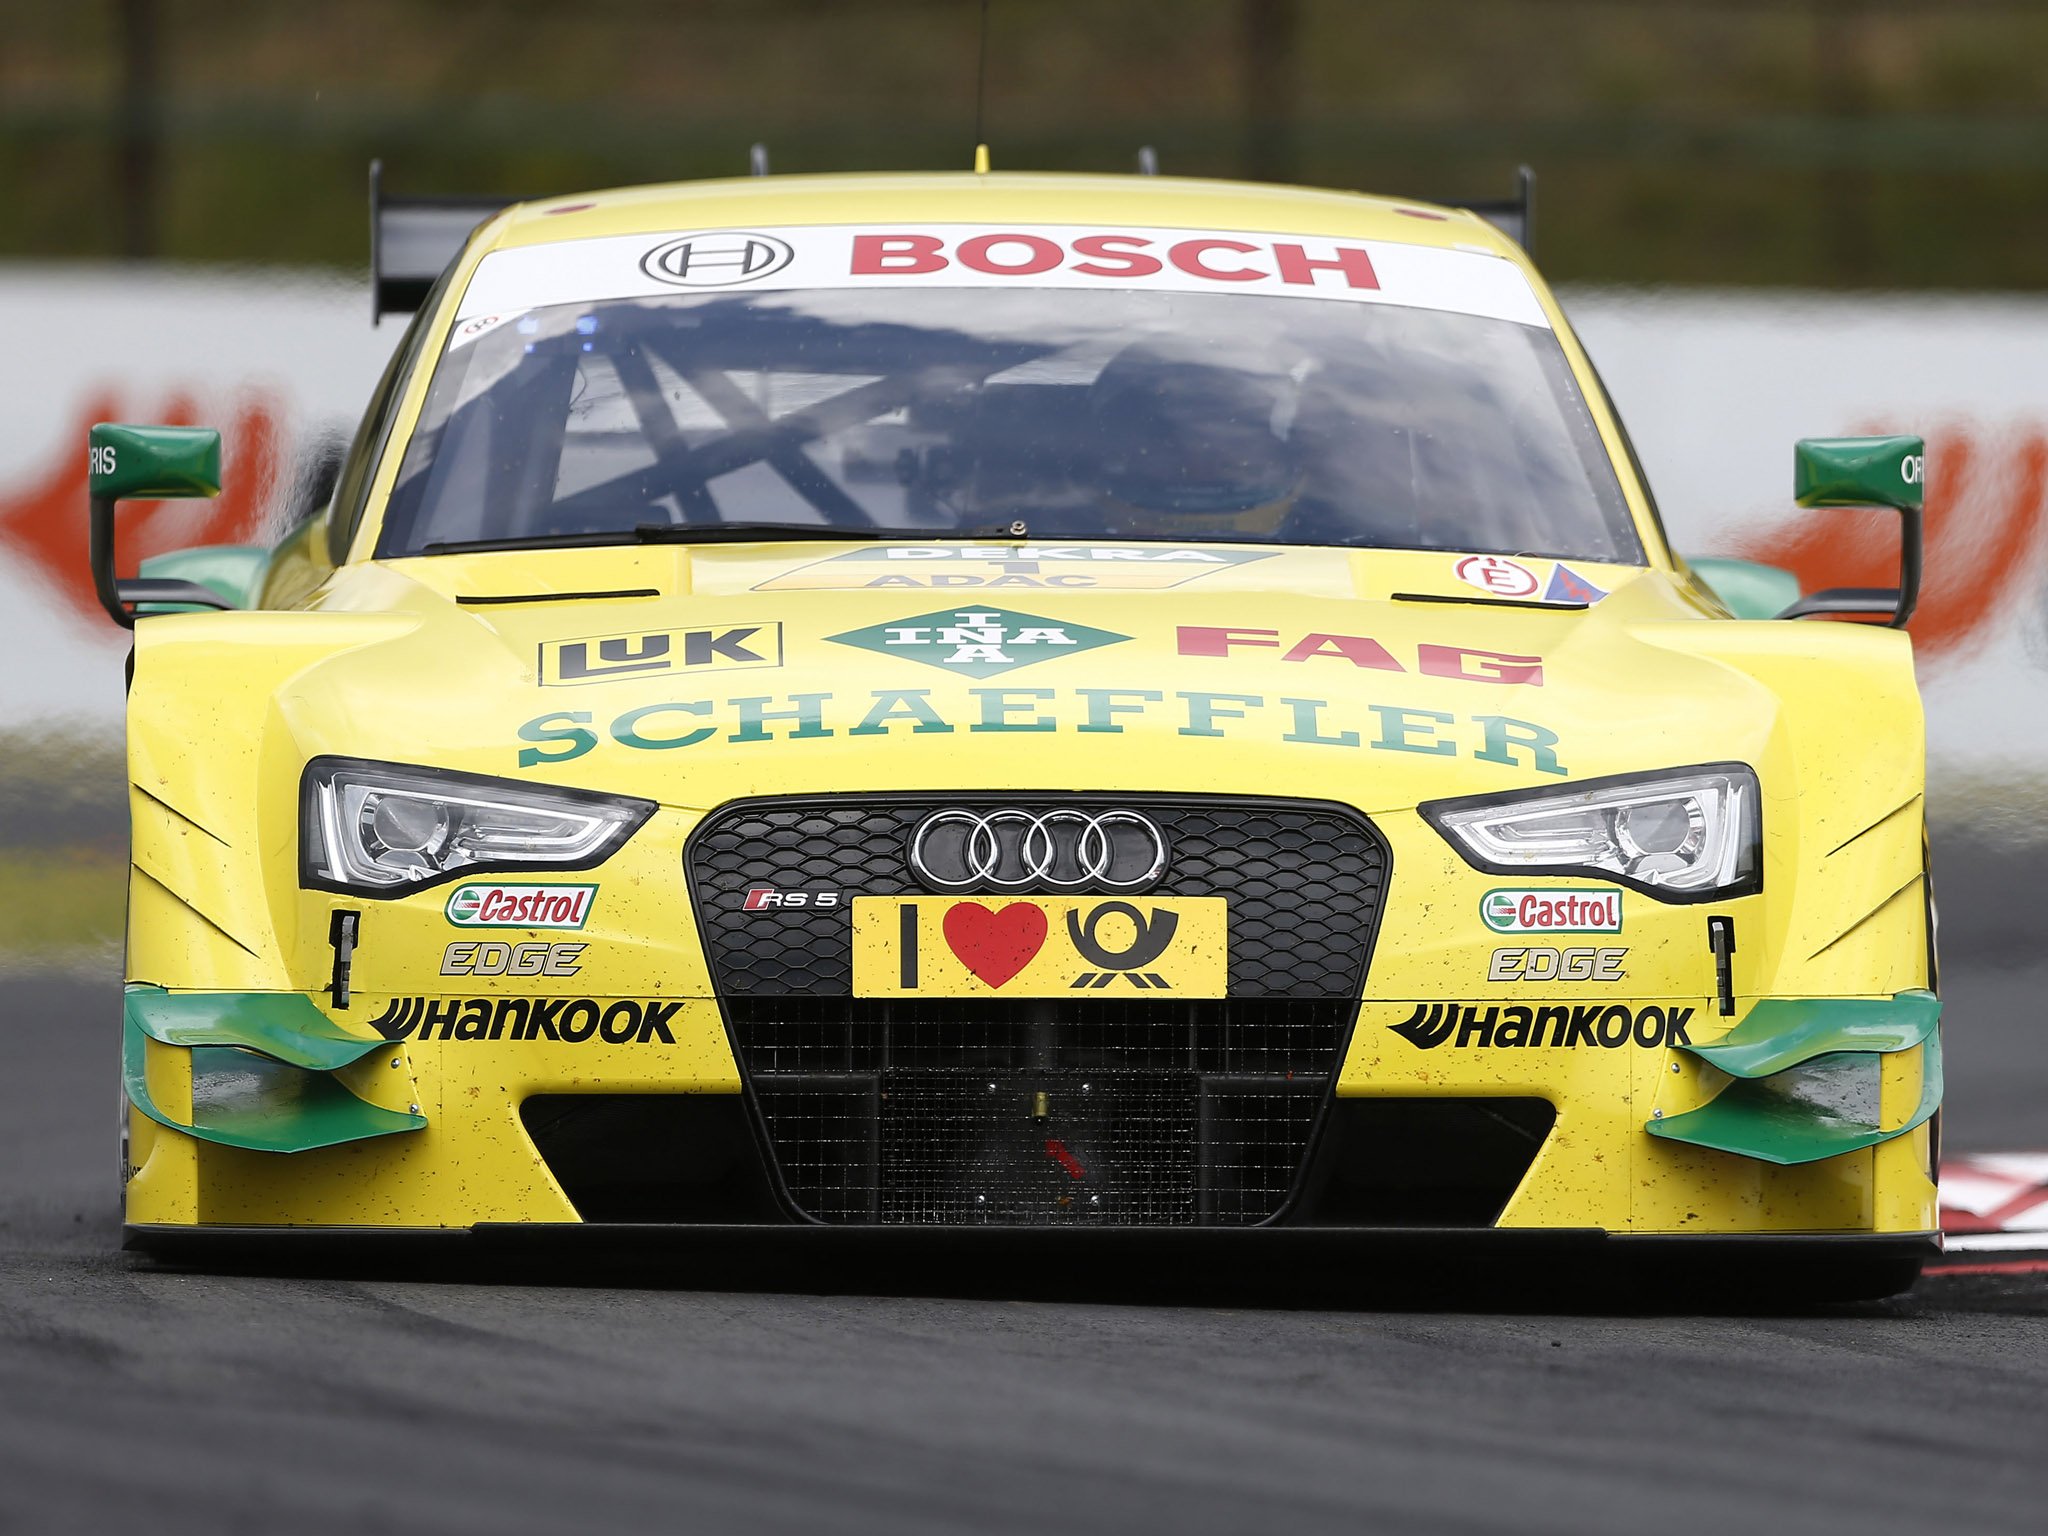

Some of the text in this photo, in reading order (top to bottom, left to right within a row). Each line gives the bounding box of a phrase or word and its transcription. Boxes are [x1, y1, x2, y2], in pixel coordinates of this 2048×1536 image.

[850, 233, 1381, 291] BOSCH
[886, 547, 1227, 562] DEKRA
[864, 575, 1102, 588] ADAC
[1176, 626, 1544, 687] FAG
[517, 688, 1569, 777] SCHAEFFLER
[478, 889, 585, 923] Castrol
[757, 892, 839, 908] RS 5
[1518, 894, 1617, 927] Castrol
[439, 941, 590, 977] EDGE
[1487, 947, 1630, 982] EDGE
